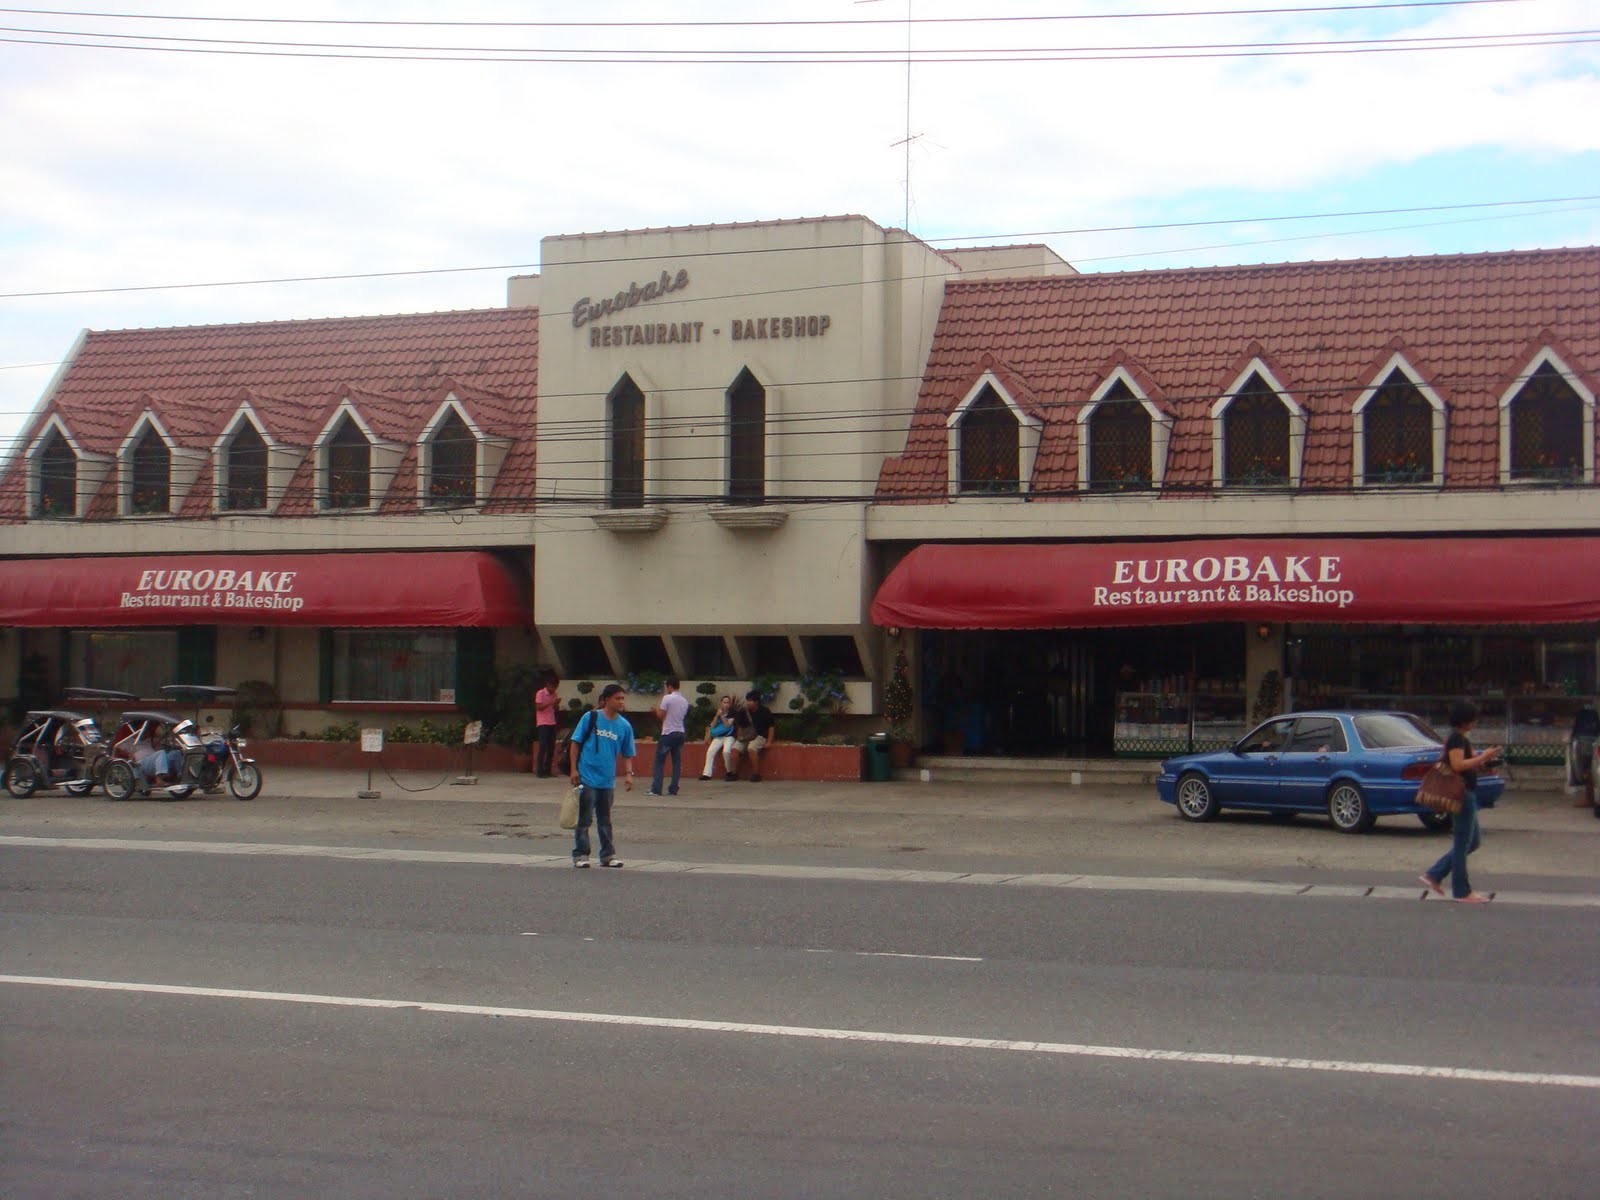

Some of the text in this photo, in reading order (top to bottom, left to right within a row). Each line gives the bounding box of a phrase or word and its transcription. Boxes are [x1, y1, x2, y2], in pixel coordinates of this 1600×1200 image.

[572, 268, 690, 328] Eurobake
[590, 321, 704, 347] RESTAURANT
[731, 314, 831, 341] BAKESHOP
[136, 569, 297, 593] EUROBAKE
[1112, 555, 1343, 584] EUROBAKE
[120, 592, 304, 612] Restaurant & Bakeshop
[1093, 584, 1354, 608] Restaurant & Bakeshop
